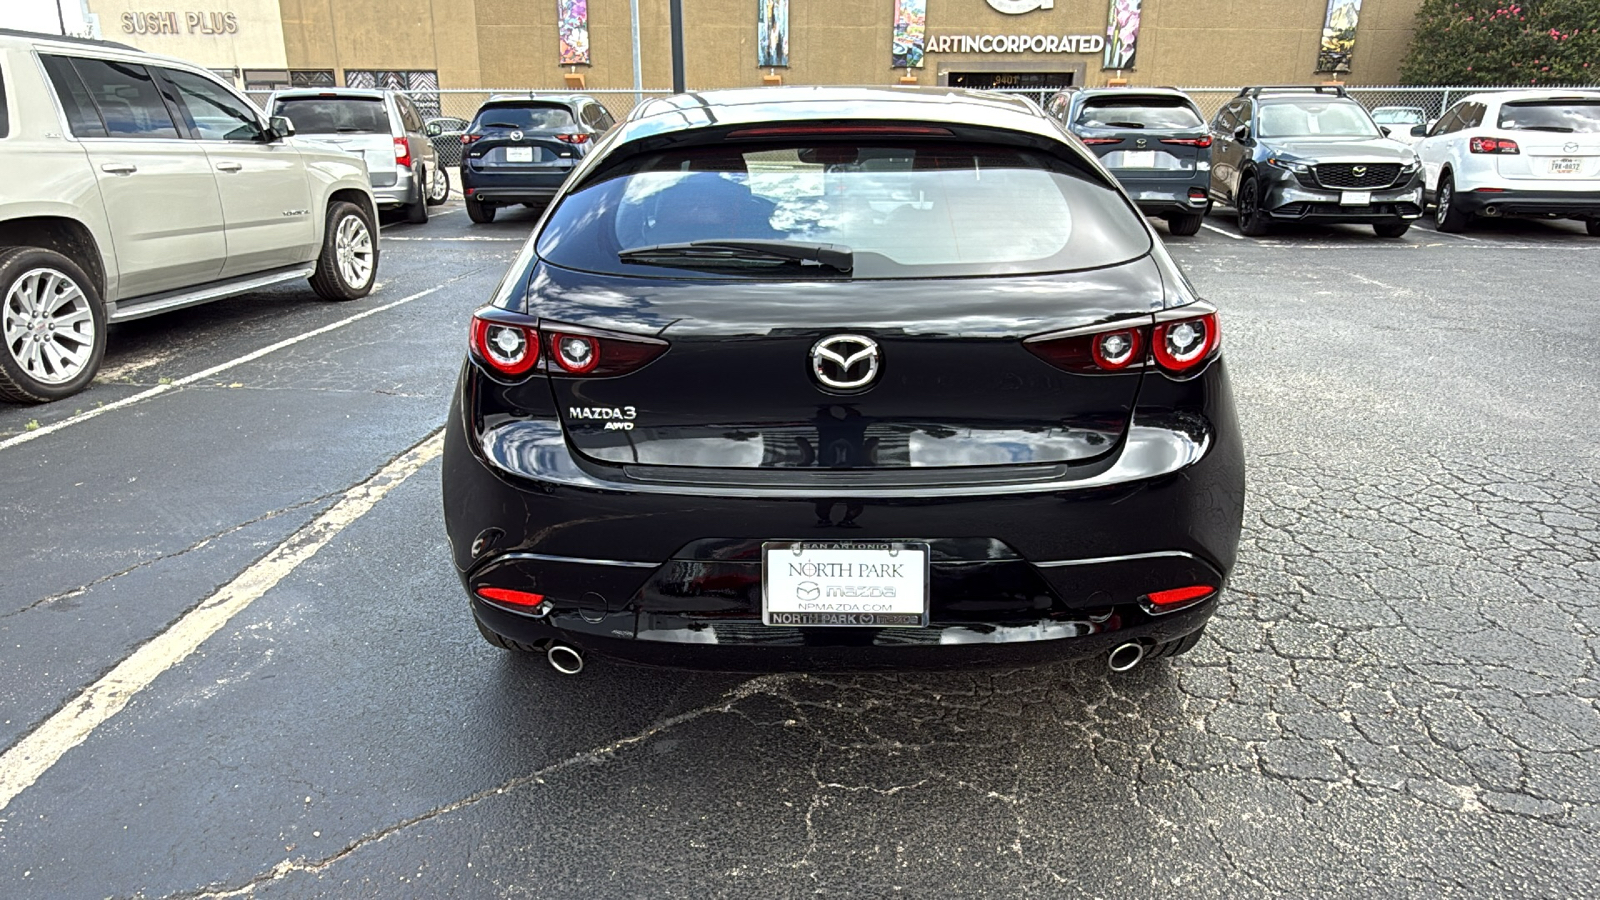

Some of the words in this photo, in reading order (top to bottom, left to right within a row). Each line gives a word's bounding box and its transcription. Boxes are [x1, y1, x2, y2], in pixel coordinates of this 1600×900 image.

[121, 12, 179, 34] SUSHI
[185, 12, 239, 34] PLUS
[926, 35, 1104, 53] ARTINCORPORATED
[995, 75, 1018, 84] 9401
[604, 421, 634, 431] AWD
[788, 560, 852, 577] NORTH
[859, 563, 904, 578] PARK
[773, 613, 818, 625] NORTH
[822, 614, 857, 625] PARK
